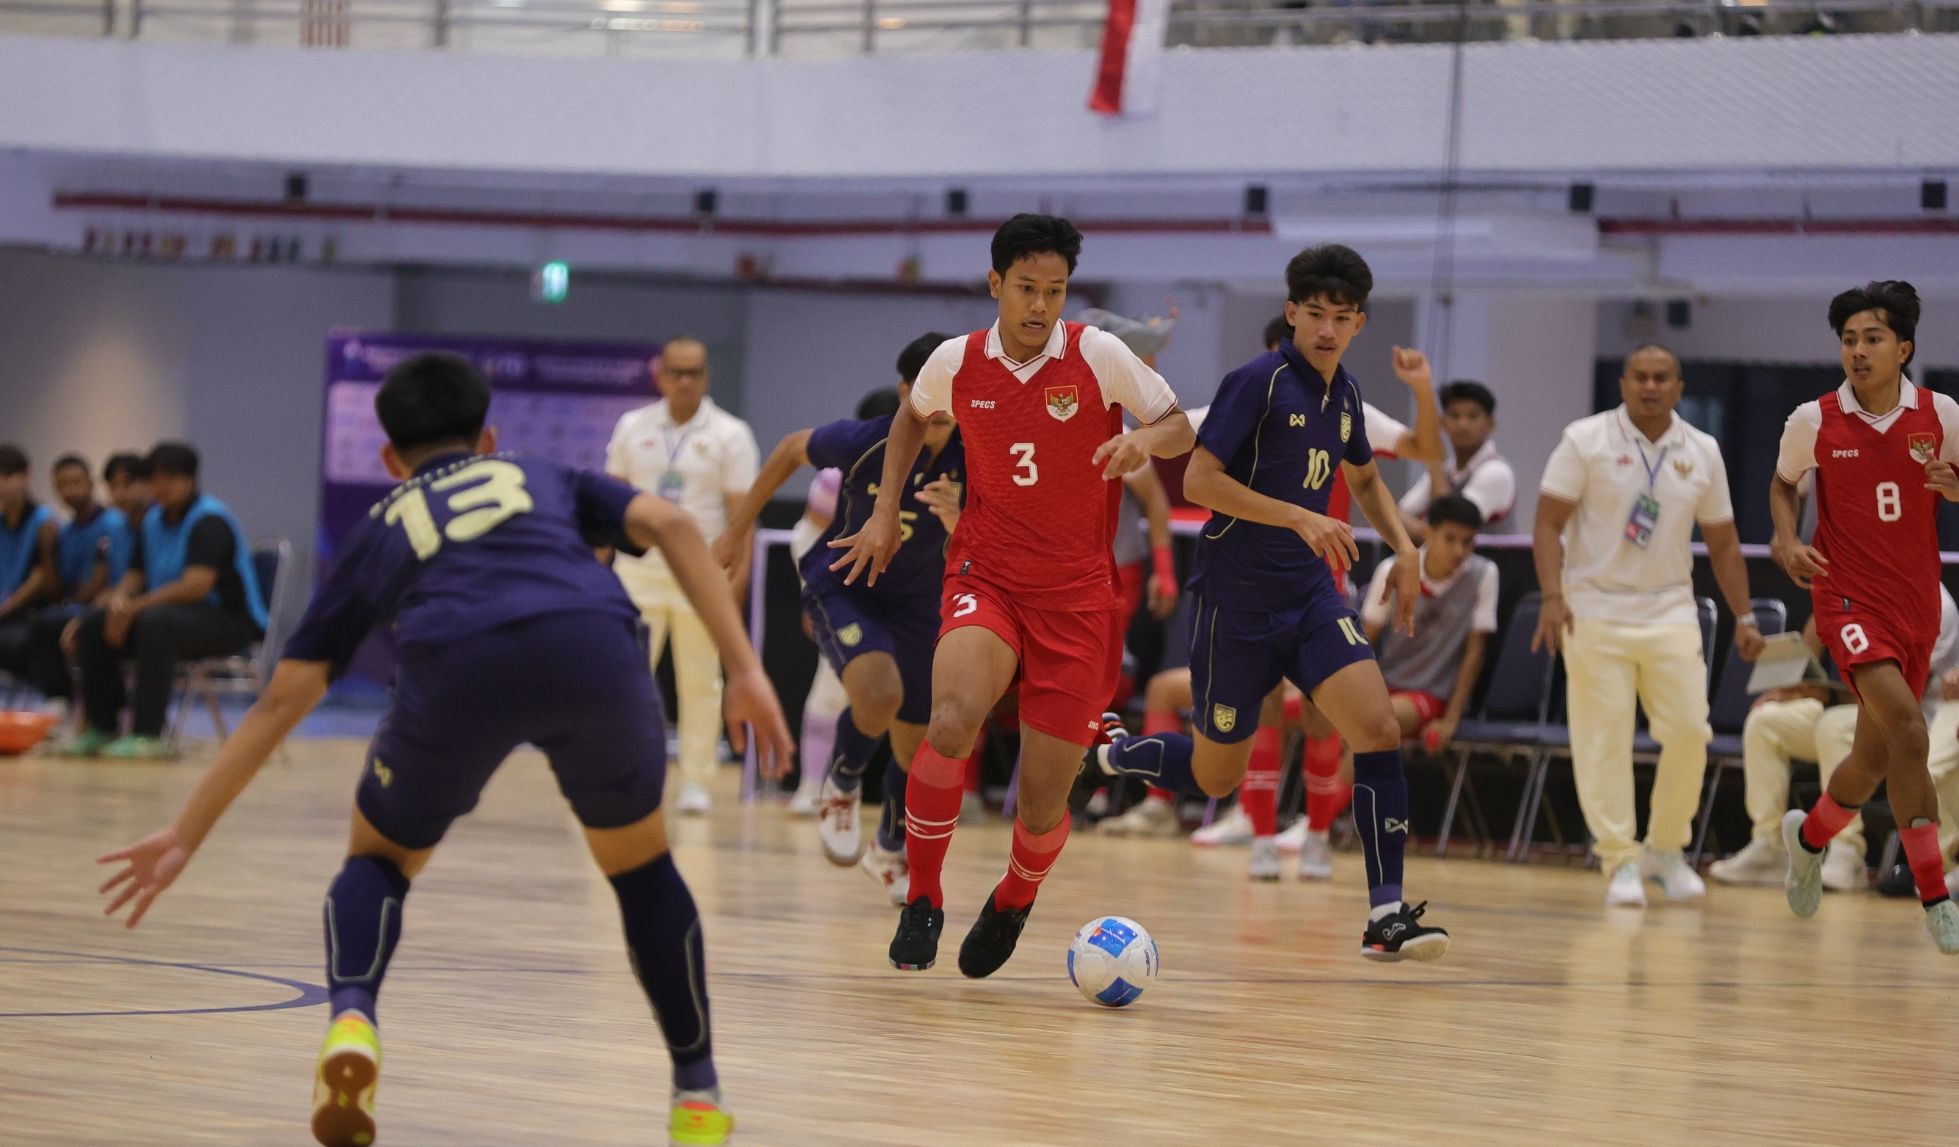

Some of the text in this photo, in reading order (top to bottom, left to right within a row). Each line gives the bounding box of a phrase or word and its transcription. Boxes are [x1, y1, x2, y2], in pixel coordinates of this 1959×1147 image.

[970, 399, 996, 409] SPECS
[1009, 442, 1039, 487] 3
[1302, 448, 1331, 490] 10
[1832, 448, 1859, 459] SPECS
[384, 459, 533, 561] 13
[1876, 481, 1901, 522] 8
[952, 593, 977, 618] 3
[1840, 623, 1869, 655] 8
